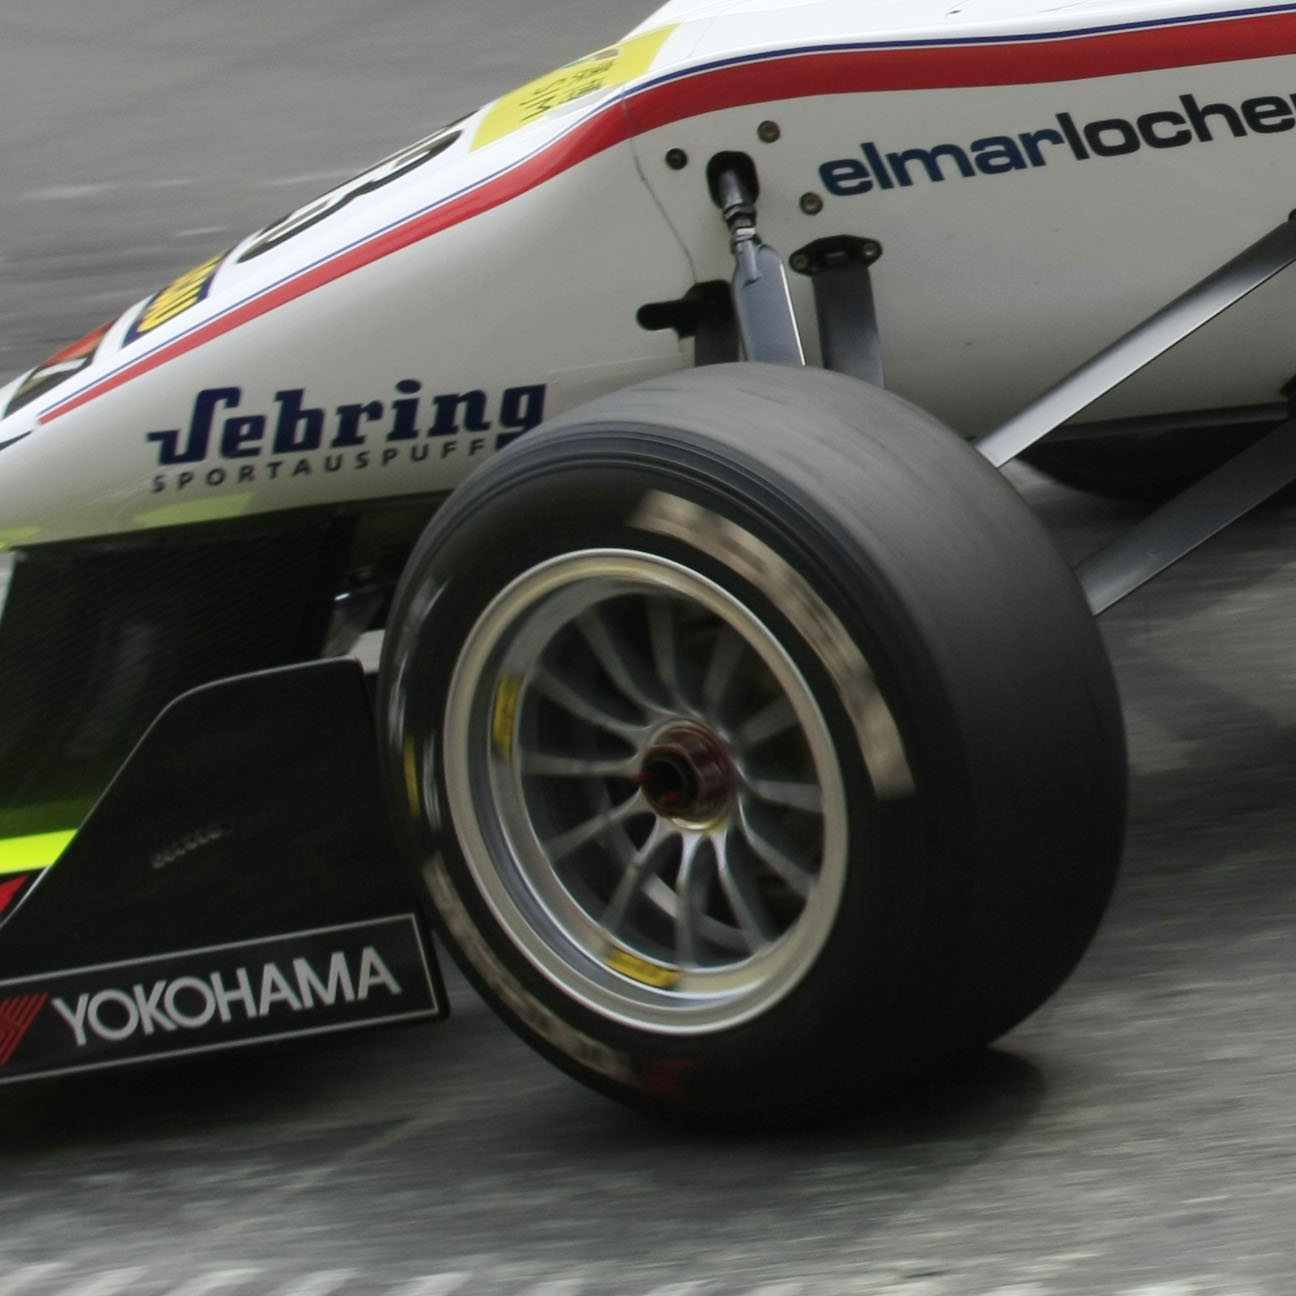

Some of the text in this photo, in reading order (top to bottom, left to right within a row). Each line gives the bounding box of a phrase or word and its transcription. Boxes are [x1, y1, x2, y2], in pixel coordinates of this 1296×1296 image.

[146, 379, 548, 466] Sebring
[152, 439, 494, 494] SPORTAUSPUFF
[53, 946, 402, 1047] YOKOHAMA
